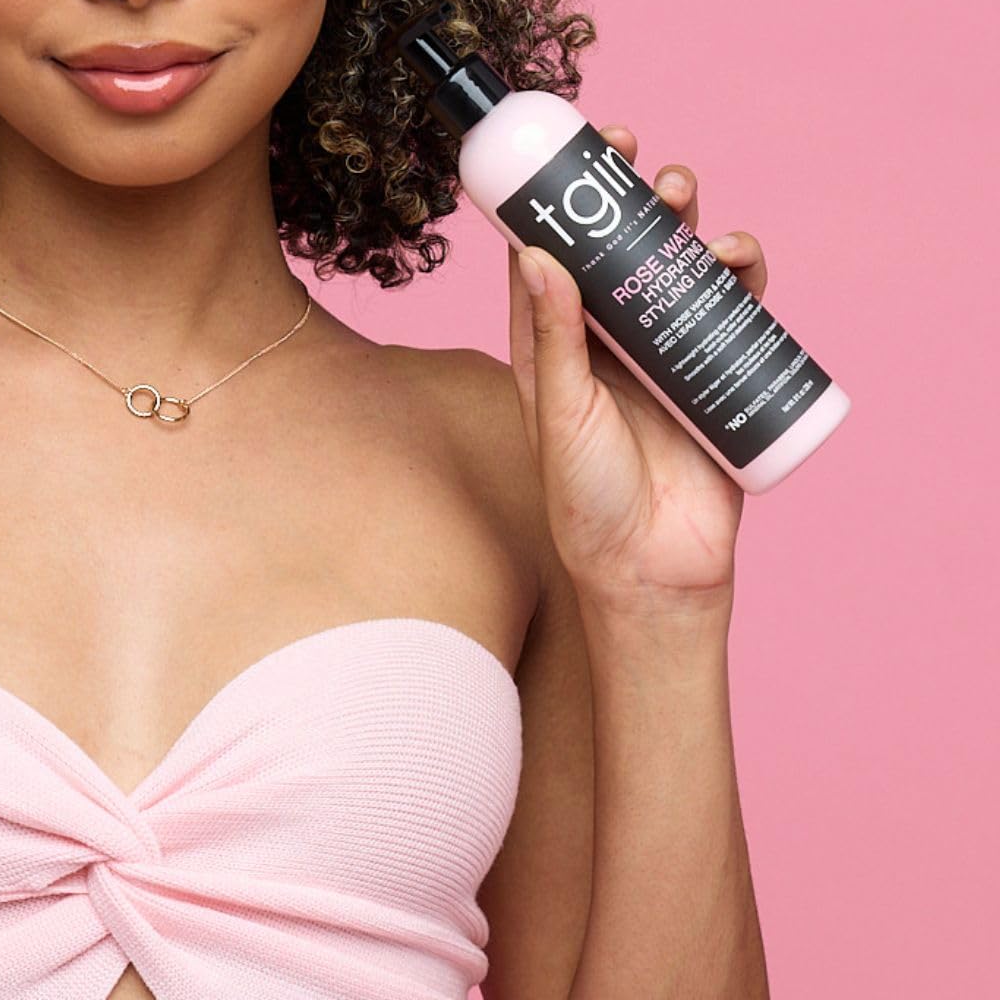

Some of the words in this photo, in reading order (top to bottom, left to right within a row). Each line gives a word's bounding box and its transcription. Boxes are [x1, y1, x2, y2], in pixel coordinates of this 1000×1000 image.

[529, 146, 639, 246] tgin
[605, 233, 623, 251] God
[612, 255, 663, 304] ROSE
[657, 223, 692, 258] WATE
[642, 240, 702, 302] HYDRATING
[639, 275, 694, 327] STYLING
[690, 249, 715, 278] LOTIO
[652, 327, 672, 346] WITH
[669, 308, 692, 330] ROSE
[688, 287, 713, 312] WATER
[657, 334, 677, 354] AVEC
[674, 317, 696, 338] L'EAU
[693, 307, 707, 321] DE
[703, 291, 723, 311] ROSE
